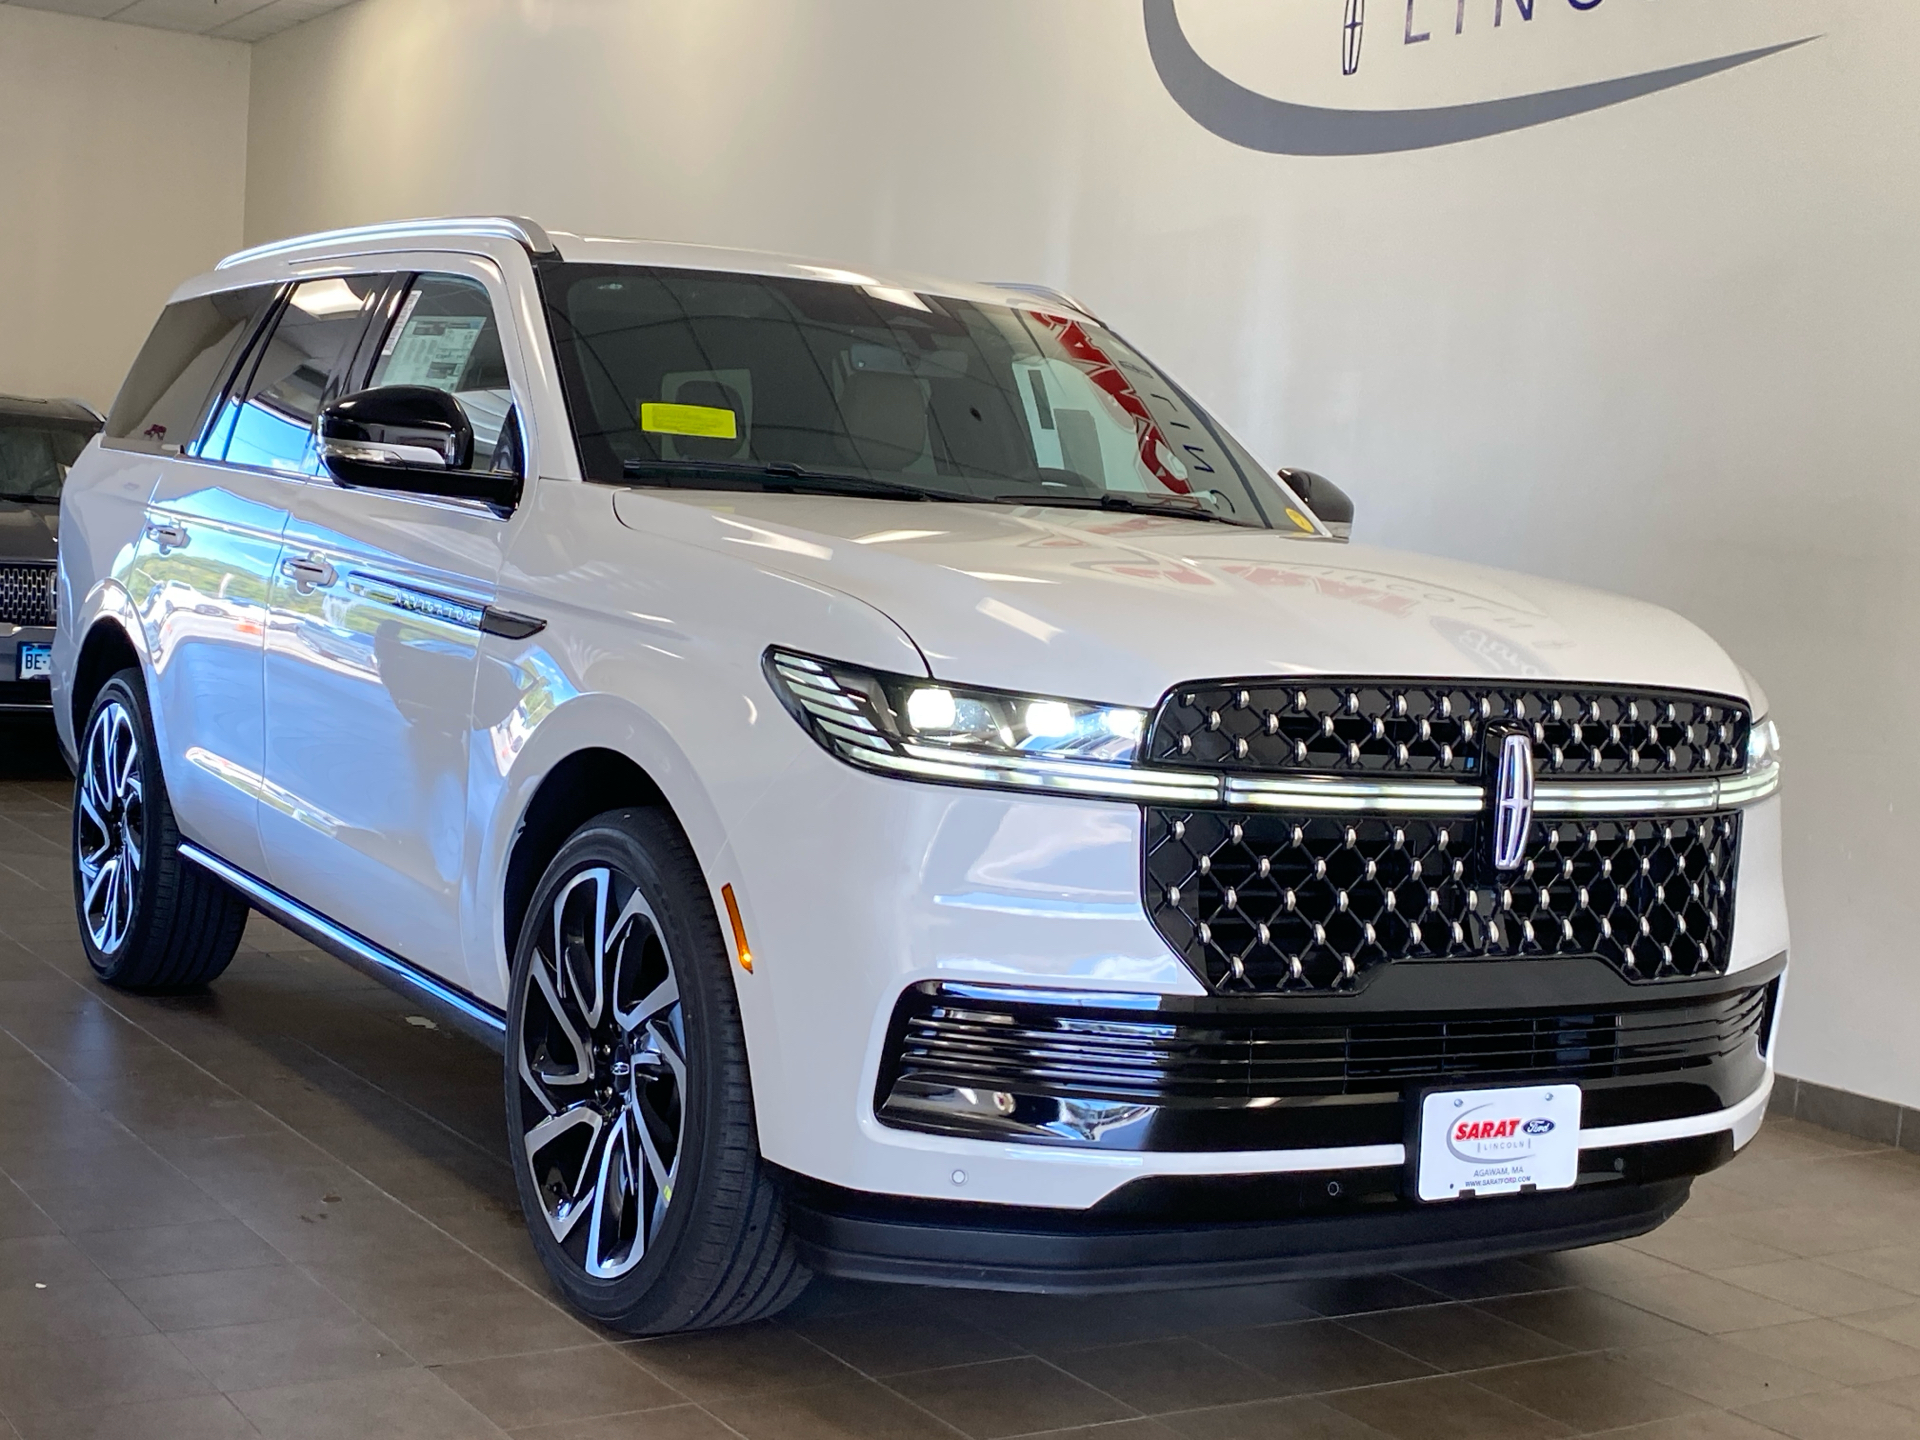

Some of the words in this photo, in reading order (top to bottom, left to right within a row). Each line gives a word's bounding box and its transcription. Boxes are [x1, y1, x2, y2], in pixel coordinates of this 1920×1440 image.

[1454, 1118, 1521, 1141] SARAT
[1526, 1120, 1551, 1133] Ford
[1484, 1141, 1524, 1150] LINCOLN
[1473, 1167, 1510, 1177] AGAWAM,
[1512, 1166, 1523, 1174] MA
[1465, 1176, 1532, 1187] WWW.SARATFORD.COM
